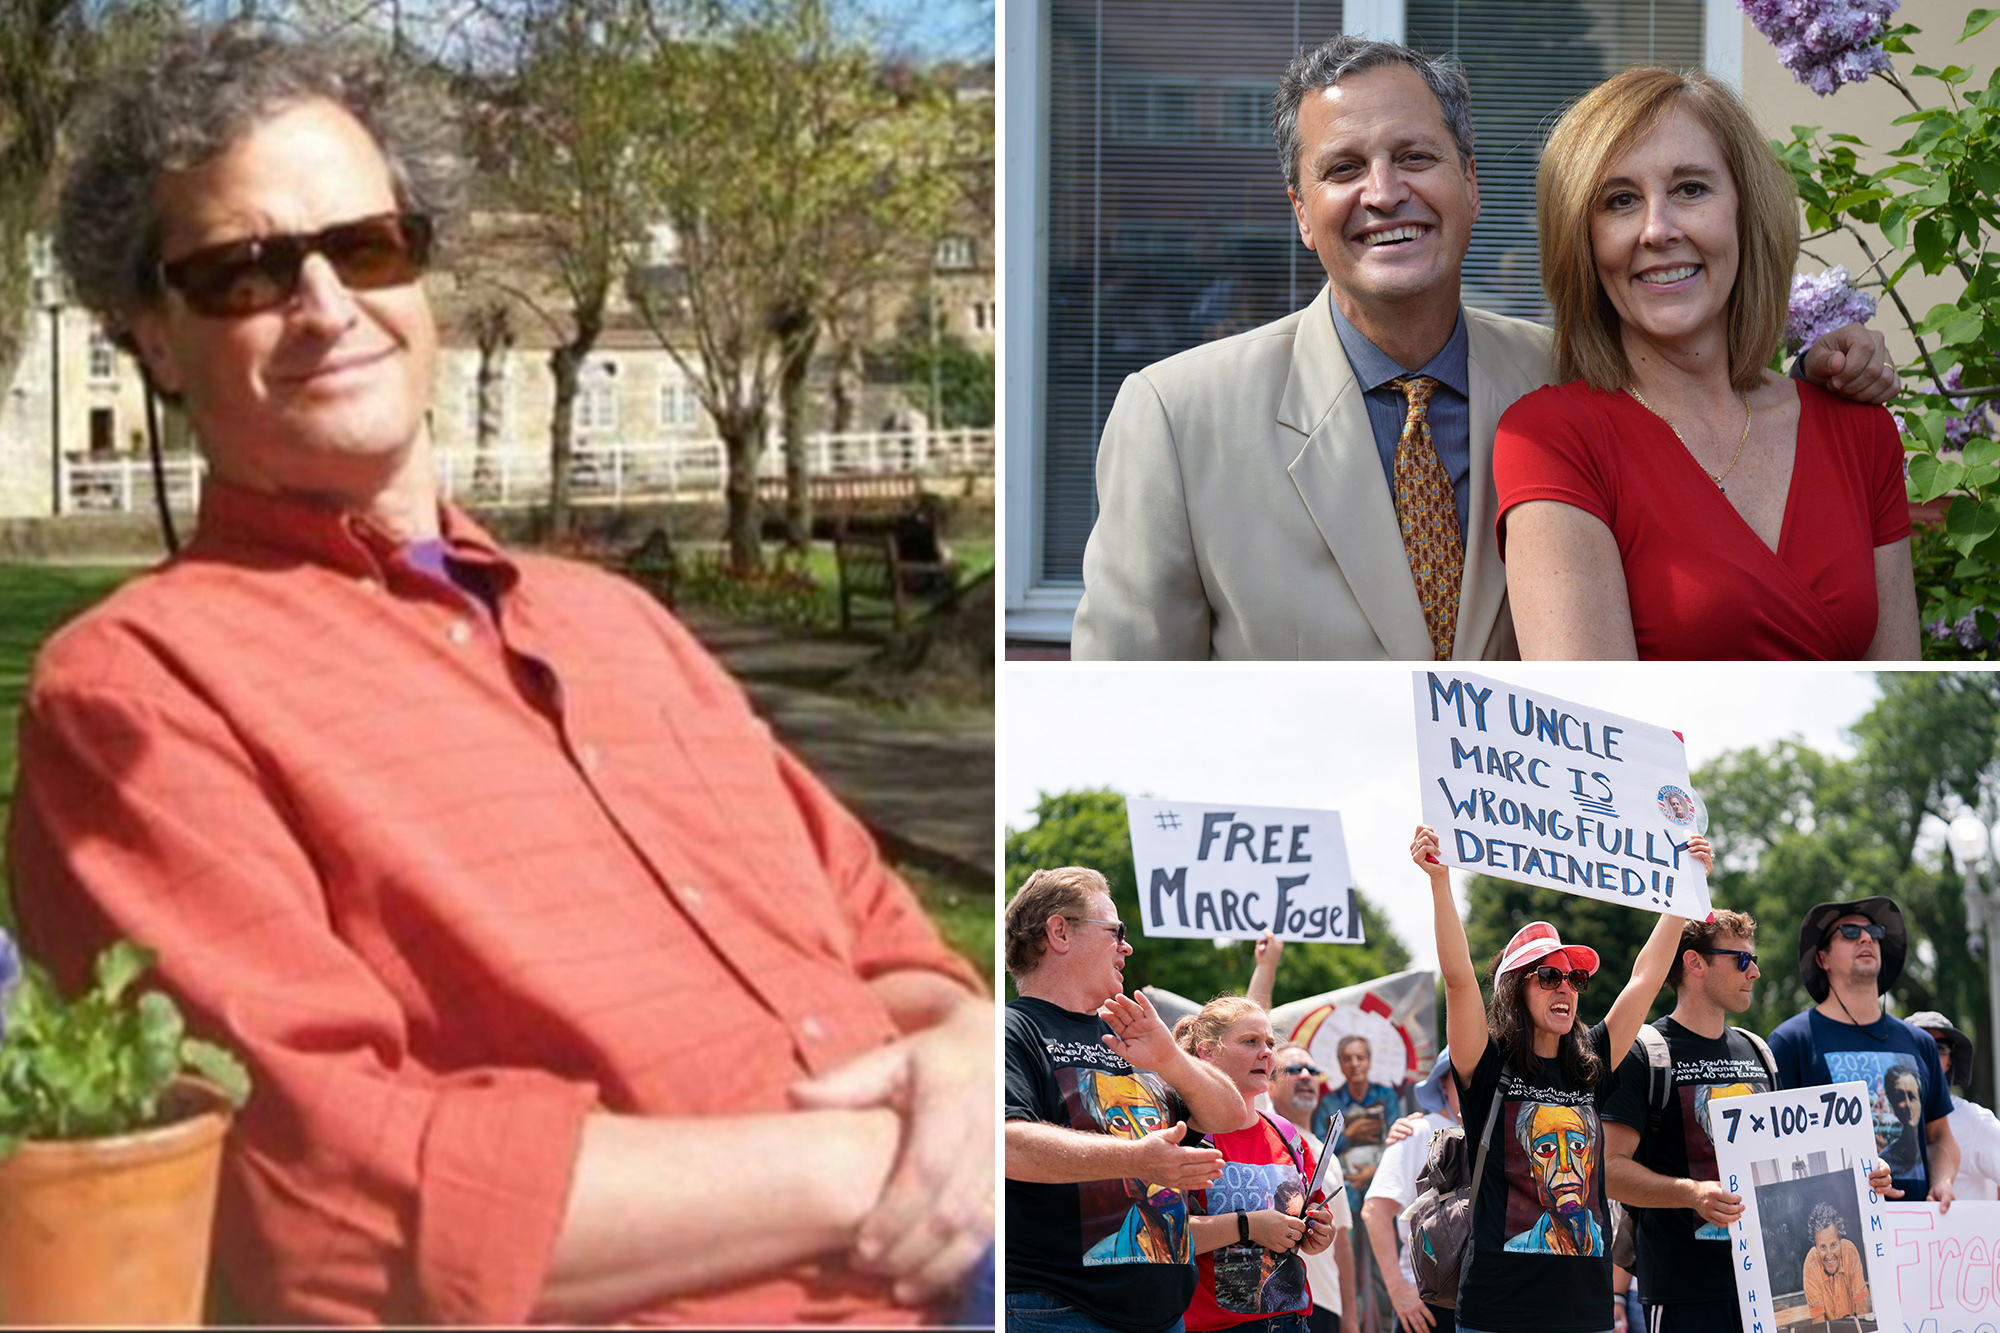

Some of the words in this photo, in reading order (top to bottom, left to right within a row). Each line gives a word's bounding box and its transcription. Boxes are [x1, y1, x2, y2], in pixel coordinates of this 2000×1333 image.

[1427, 671, 1493, 732] MY
[1508, 693, 1624, 762] UNCLE
[1450, 737, 1551, 788] MARC
[1566, 767, 1613, 803] IS
[1198, 811, 1314, 864] FREE
[1437, 777, 1689, 870] WRONGFULLY
[1149, 867, 1268, 932] MARC
[1453, 828, 1675, 907] DETAINED!!
[1703, 1071, 1717, 1079] 40
[1830, 1054, 1882, 1073] 2021
[1722, 1108, 1742, 1144] 7
